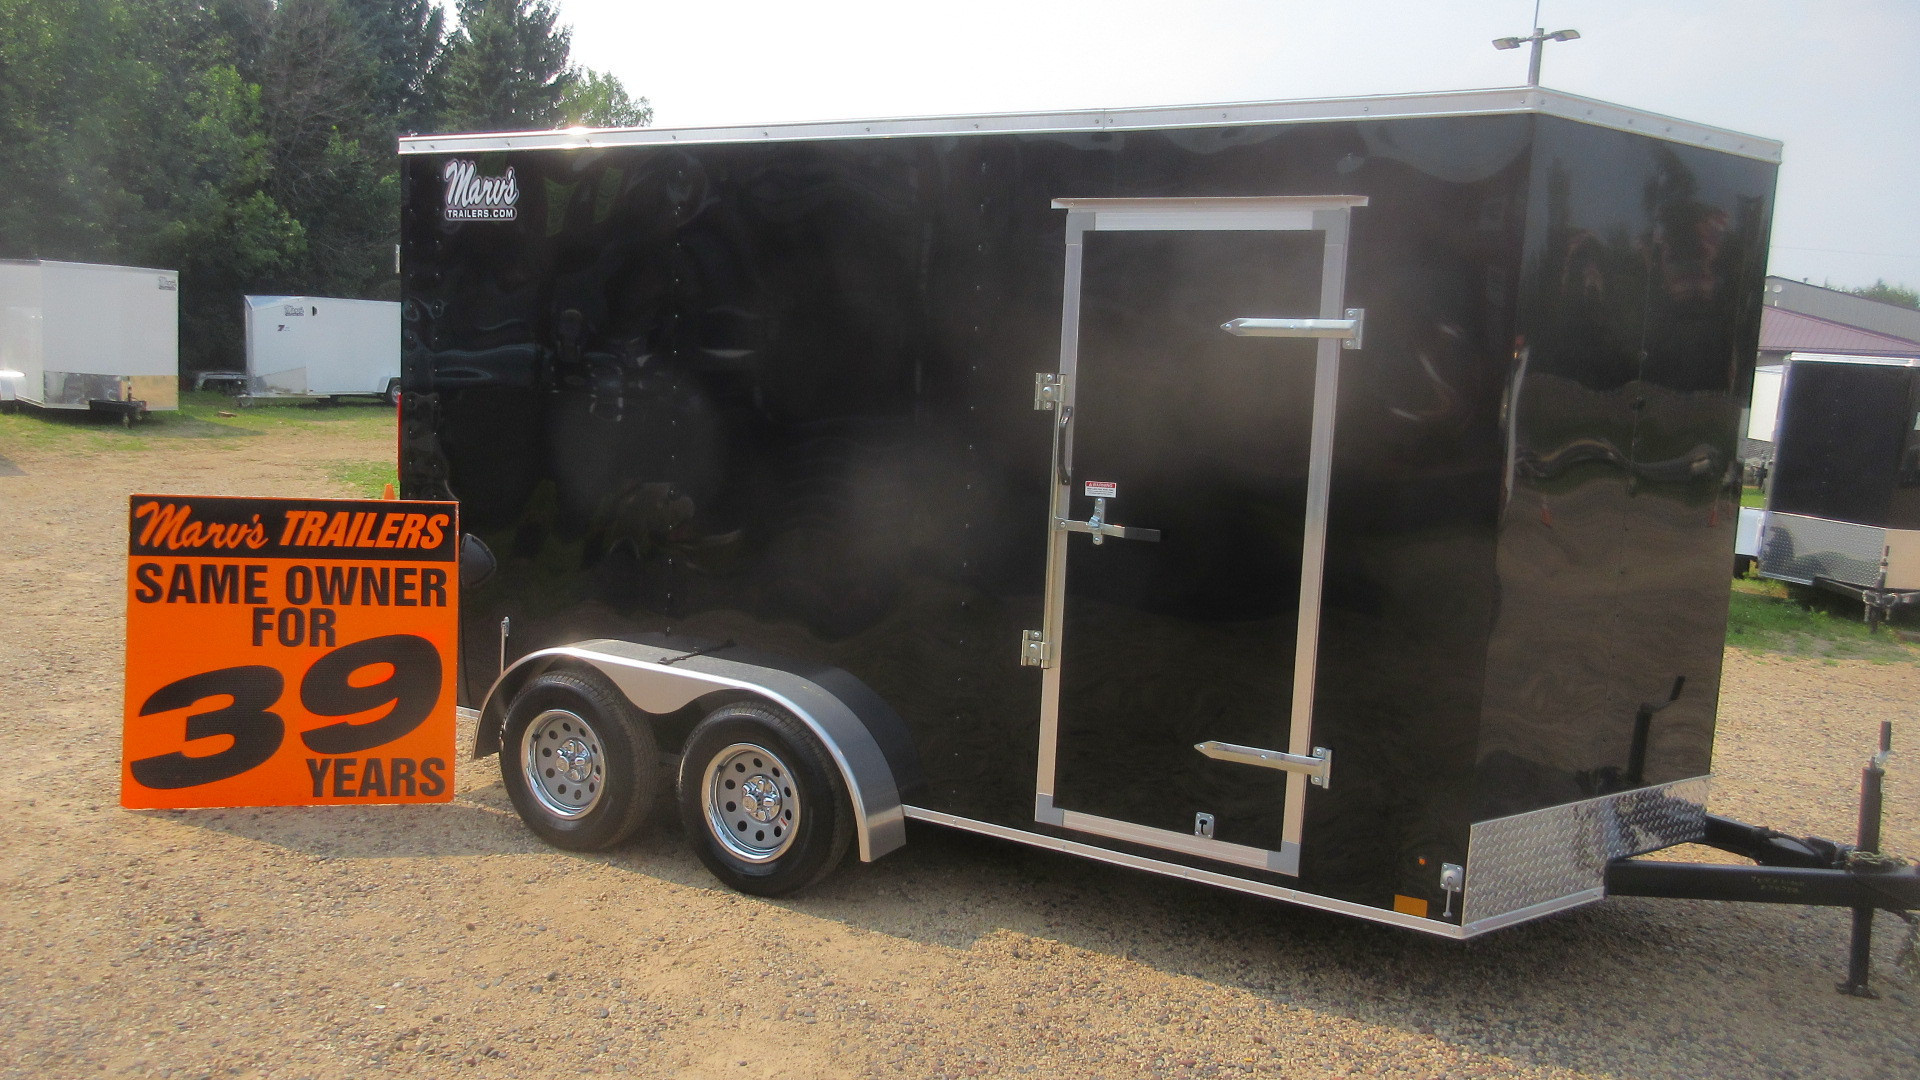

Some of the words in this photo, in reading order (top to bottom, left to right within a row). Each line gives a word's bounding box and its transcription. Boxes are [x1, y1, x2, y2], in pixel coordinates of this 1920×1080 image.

[445, 160, 518, 208] Marv's
[447, 209, 513, 218] TRAILERS.COM
[135, 500, 268, 550] Marv's
[279, 510, 449, 549] TRAILERS
[135, 562, 268, 604] SAME
[285, 565, 447, 607] OWNER
[252, 607, 336, 647] FOR
[130, 633, 443, 790] 39
[306, 757, 446, 798] YEARS
